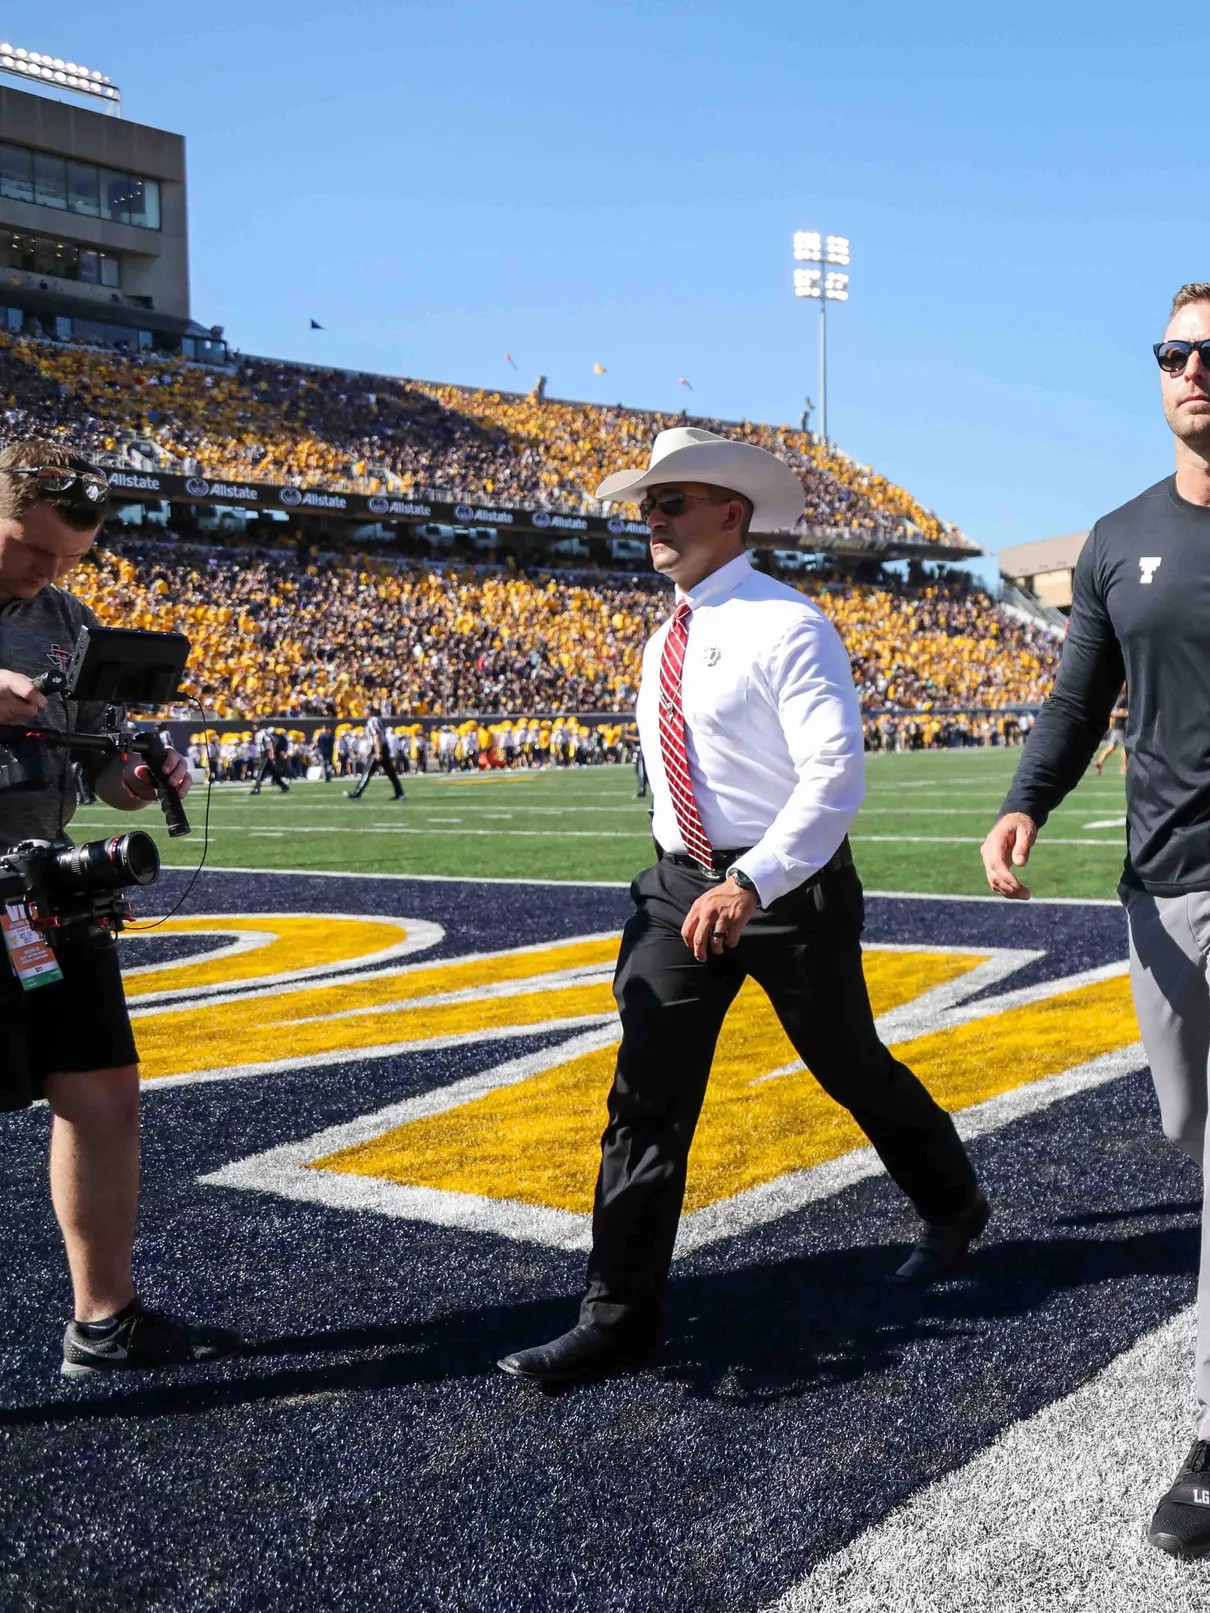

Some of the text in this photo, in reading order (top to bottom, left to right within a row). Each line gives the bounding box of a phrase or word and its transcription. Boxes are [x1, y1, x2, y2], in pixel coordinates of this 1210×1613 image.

[108, 472, 160, 490] Allstate
[210, 483, 258, 500] Allstate
[301, 492, 347, 509] Allstate
[389, 501, 431, 516] Allstate
[474, 509, 514, 524] Allstate
